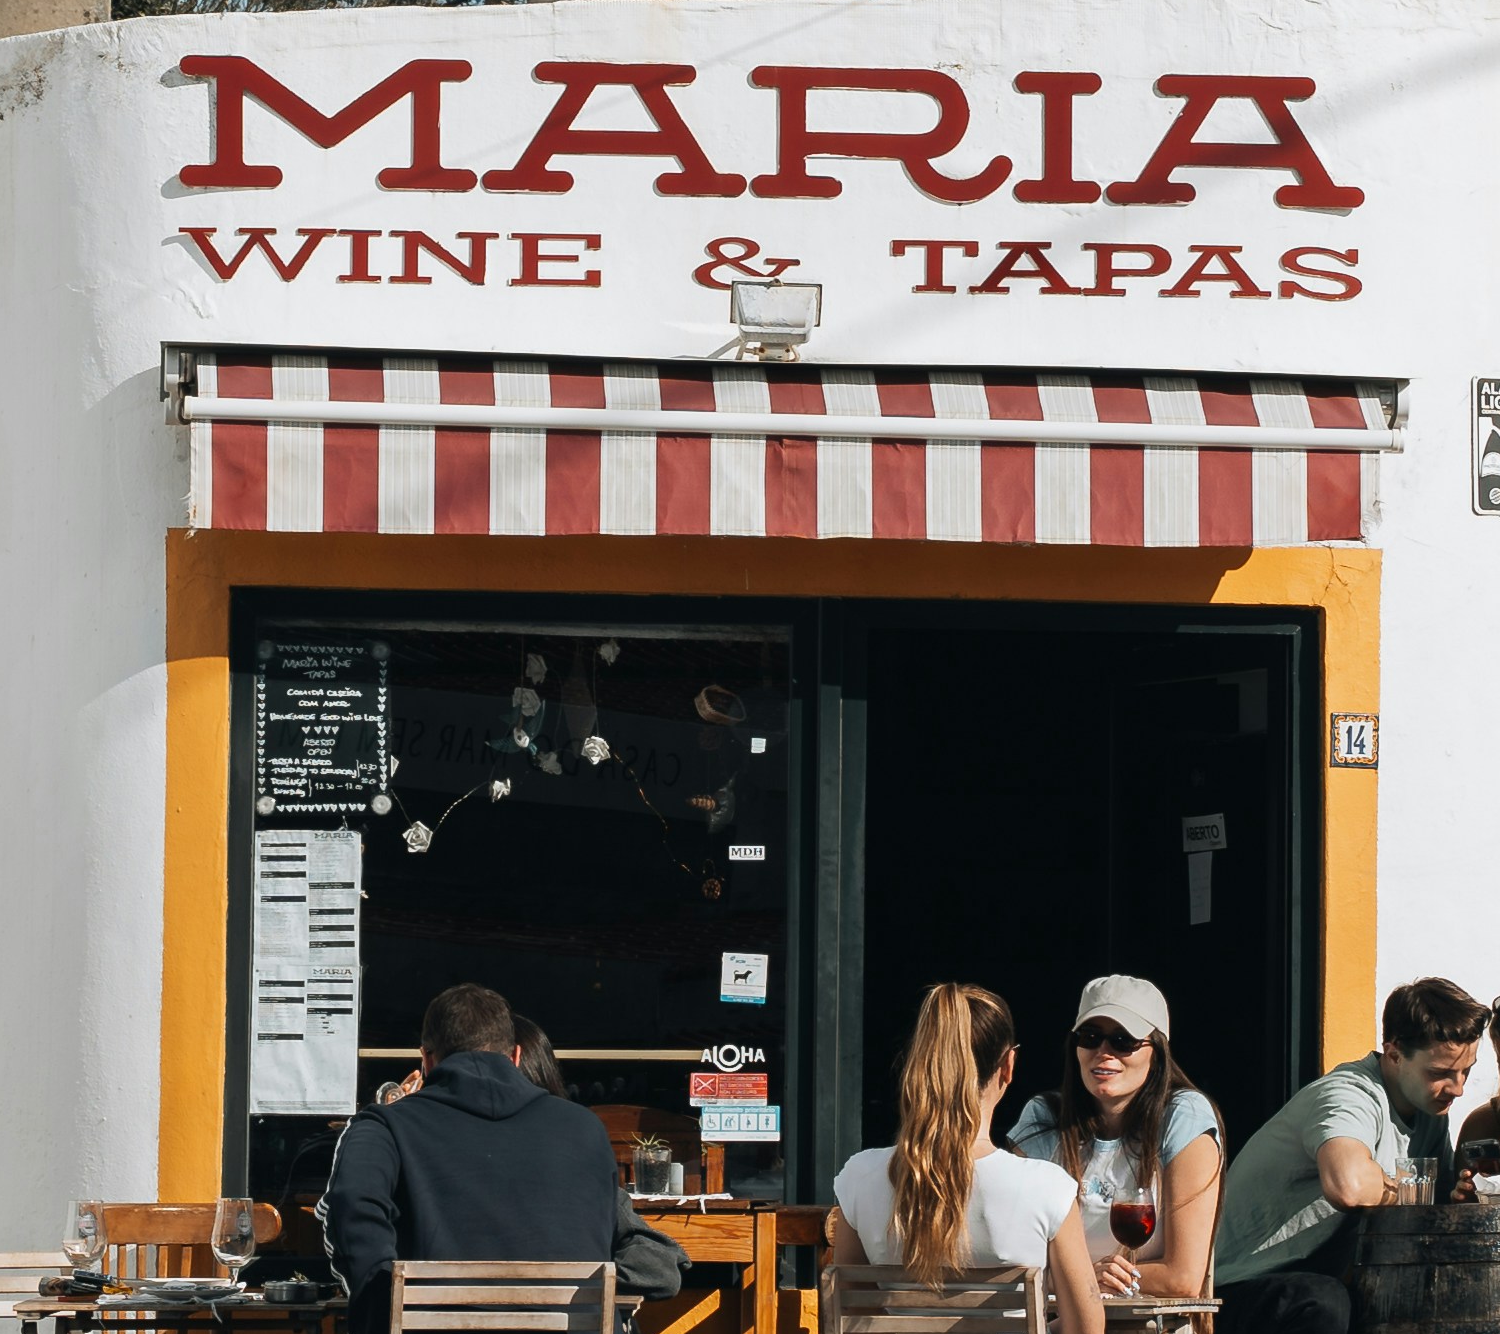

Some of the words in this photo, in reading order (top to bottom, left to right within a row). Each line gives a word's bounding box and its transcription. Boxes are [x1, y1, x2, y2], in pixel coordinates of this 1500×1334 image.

[179, 54, 1365, 209] MARIA
[178, 226, 602, 286] WINE
[693, 236, 800, 290] &
[890, 239, 1363, 302] TAPAS
[282, 656, 319, 668] MARIA
[321, 656, 352, 668] WINE
[303, 670, 336, 679] TAPAS
[307, 748, 332, 756] OPEN
[1345, 725, 1366, 754] 14
[700, 1044, 766, 1073] ALOHA
